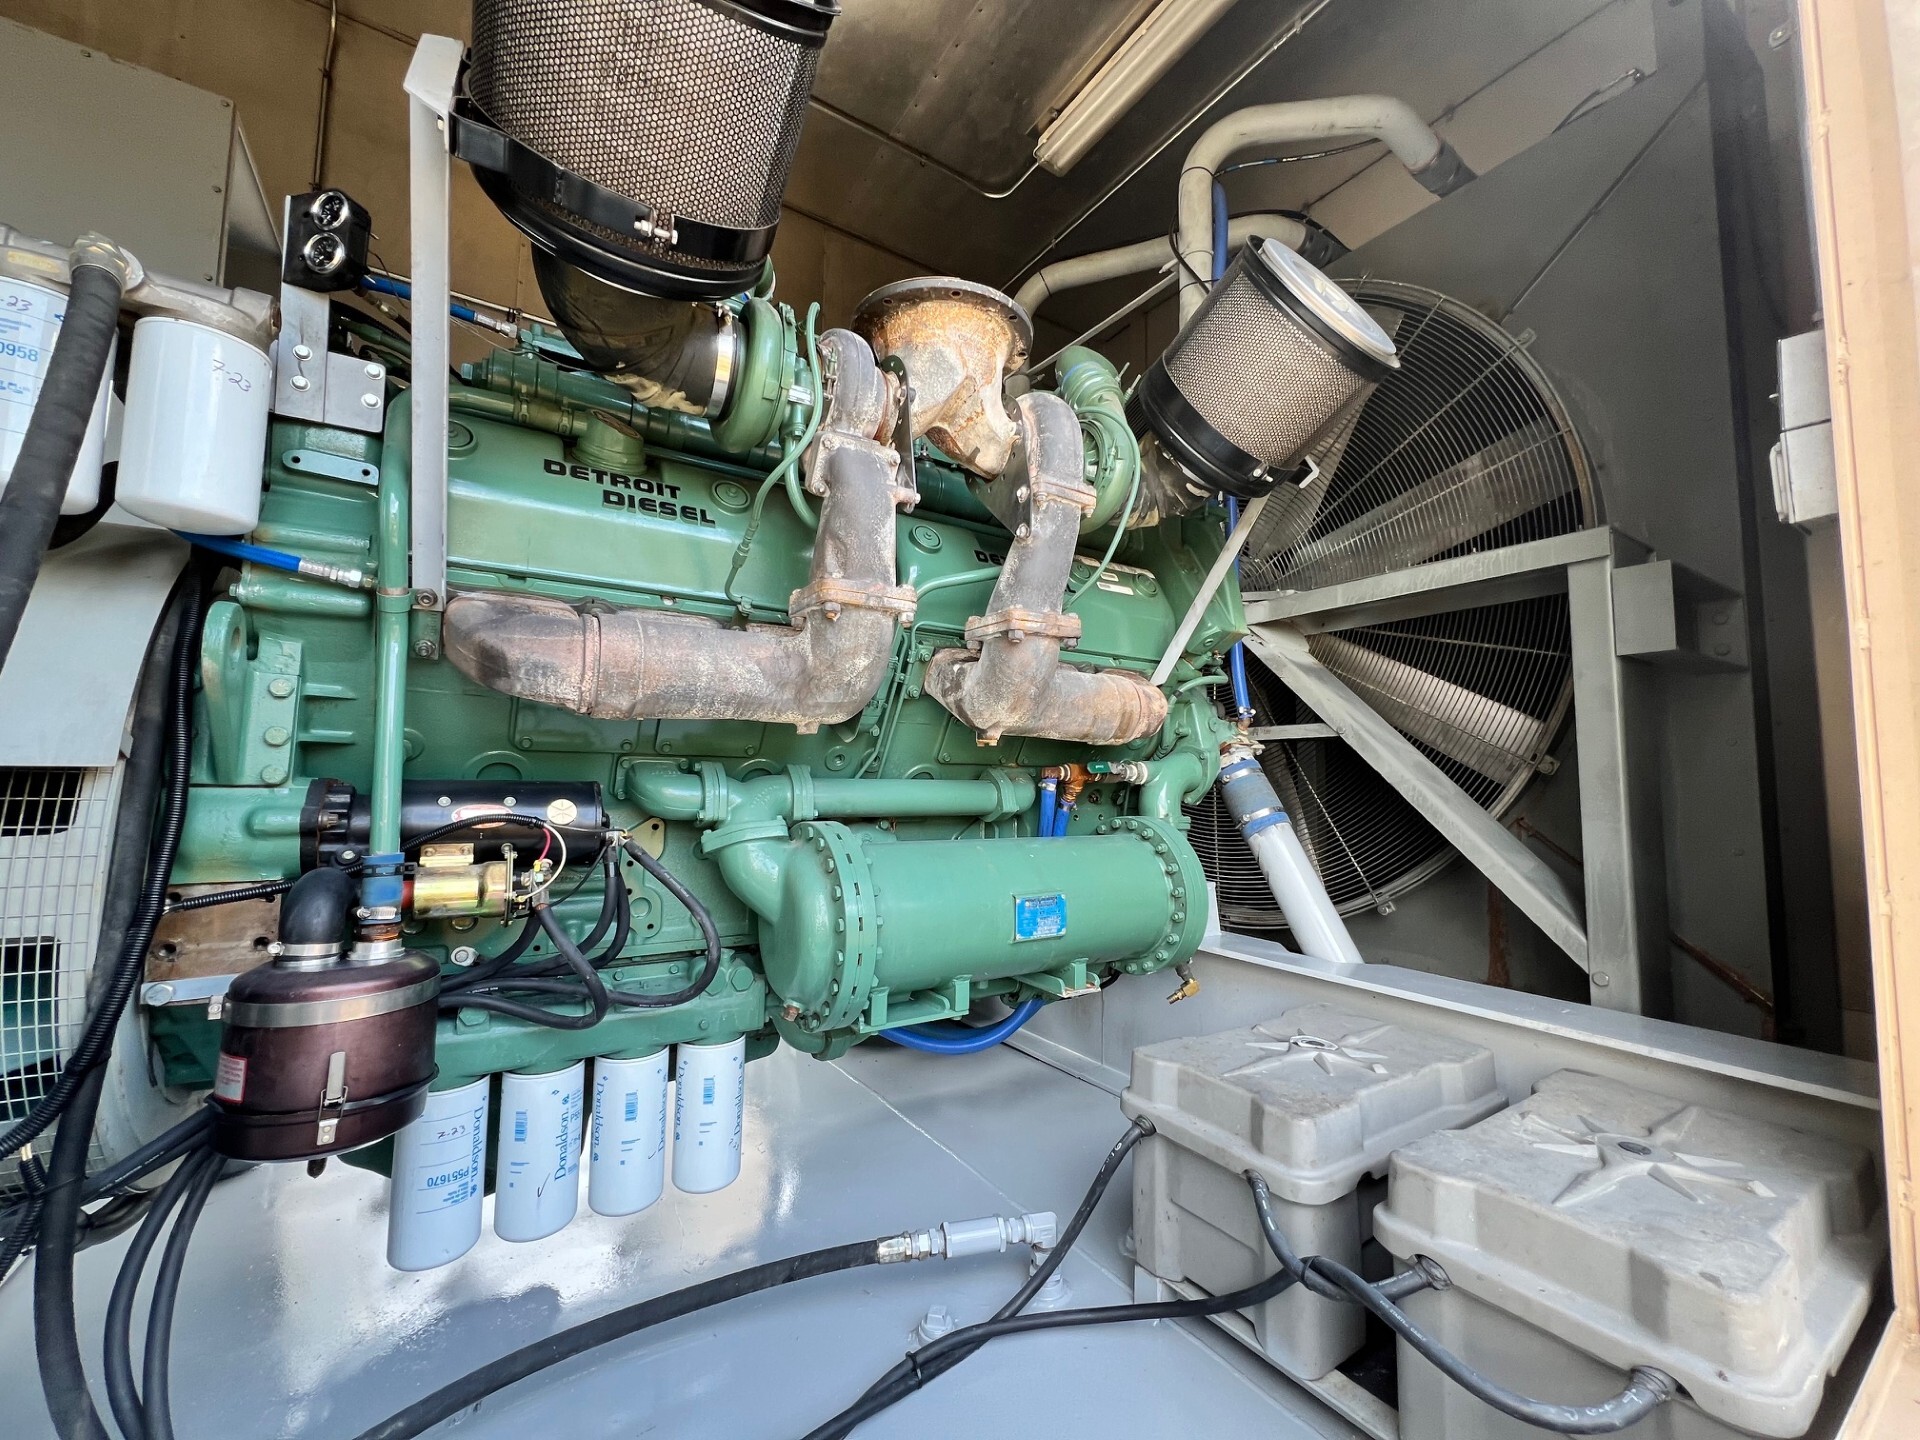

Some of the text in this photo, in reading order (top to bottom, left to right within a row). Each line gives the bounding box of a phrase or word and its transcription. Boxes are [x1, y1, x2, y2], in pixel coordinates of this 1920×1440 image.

[212, 359, 252, 392] 7-23
[543, 458, 681, 500] DETROIT
[602, 489, 716, 527] DIESEL
[427, 1166, 470, 1188] P551670
